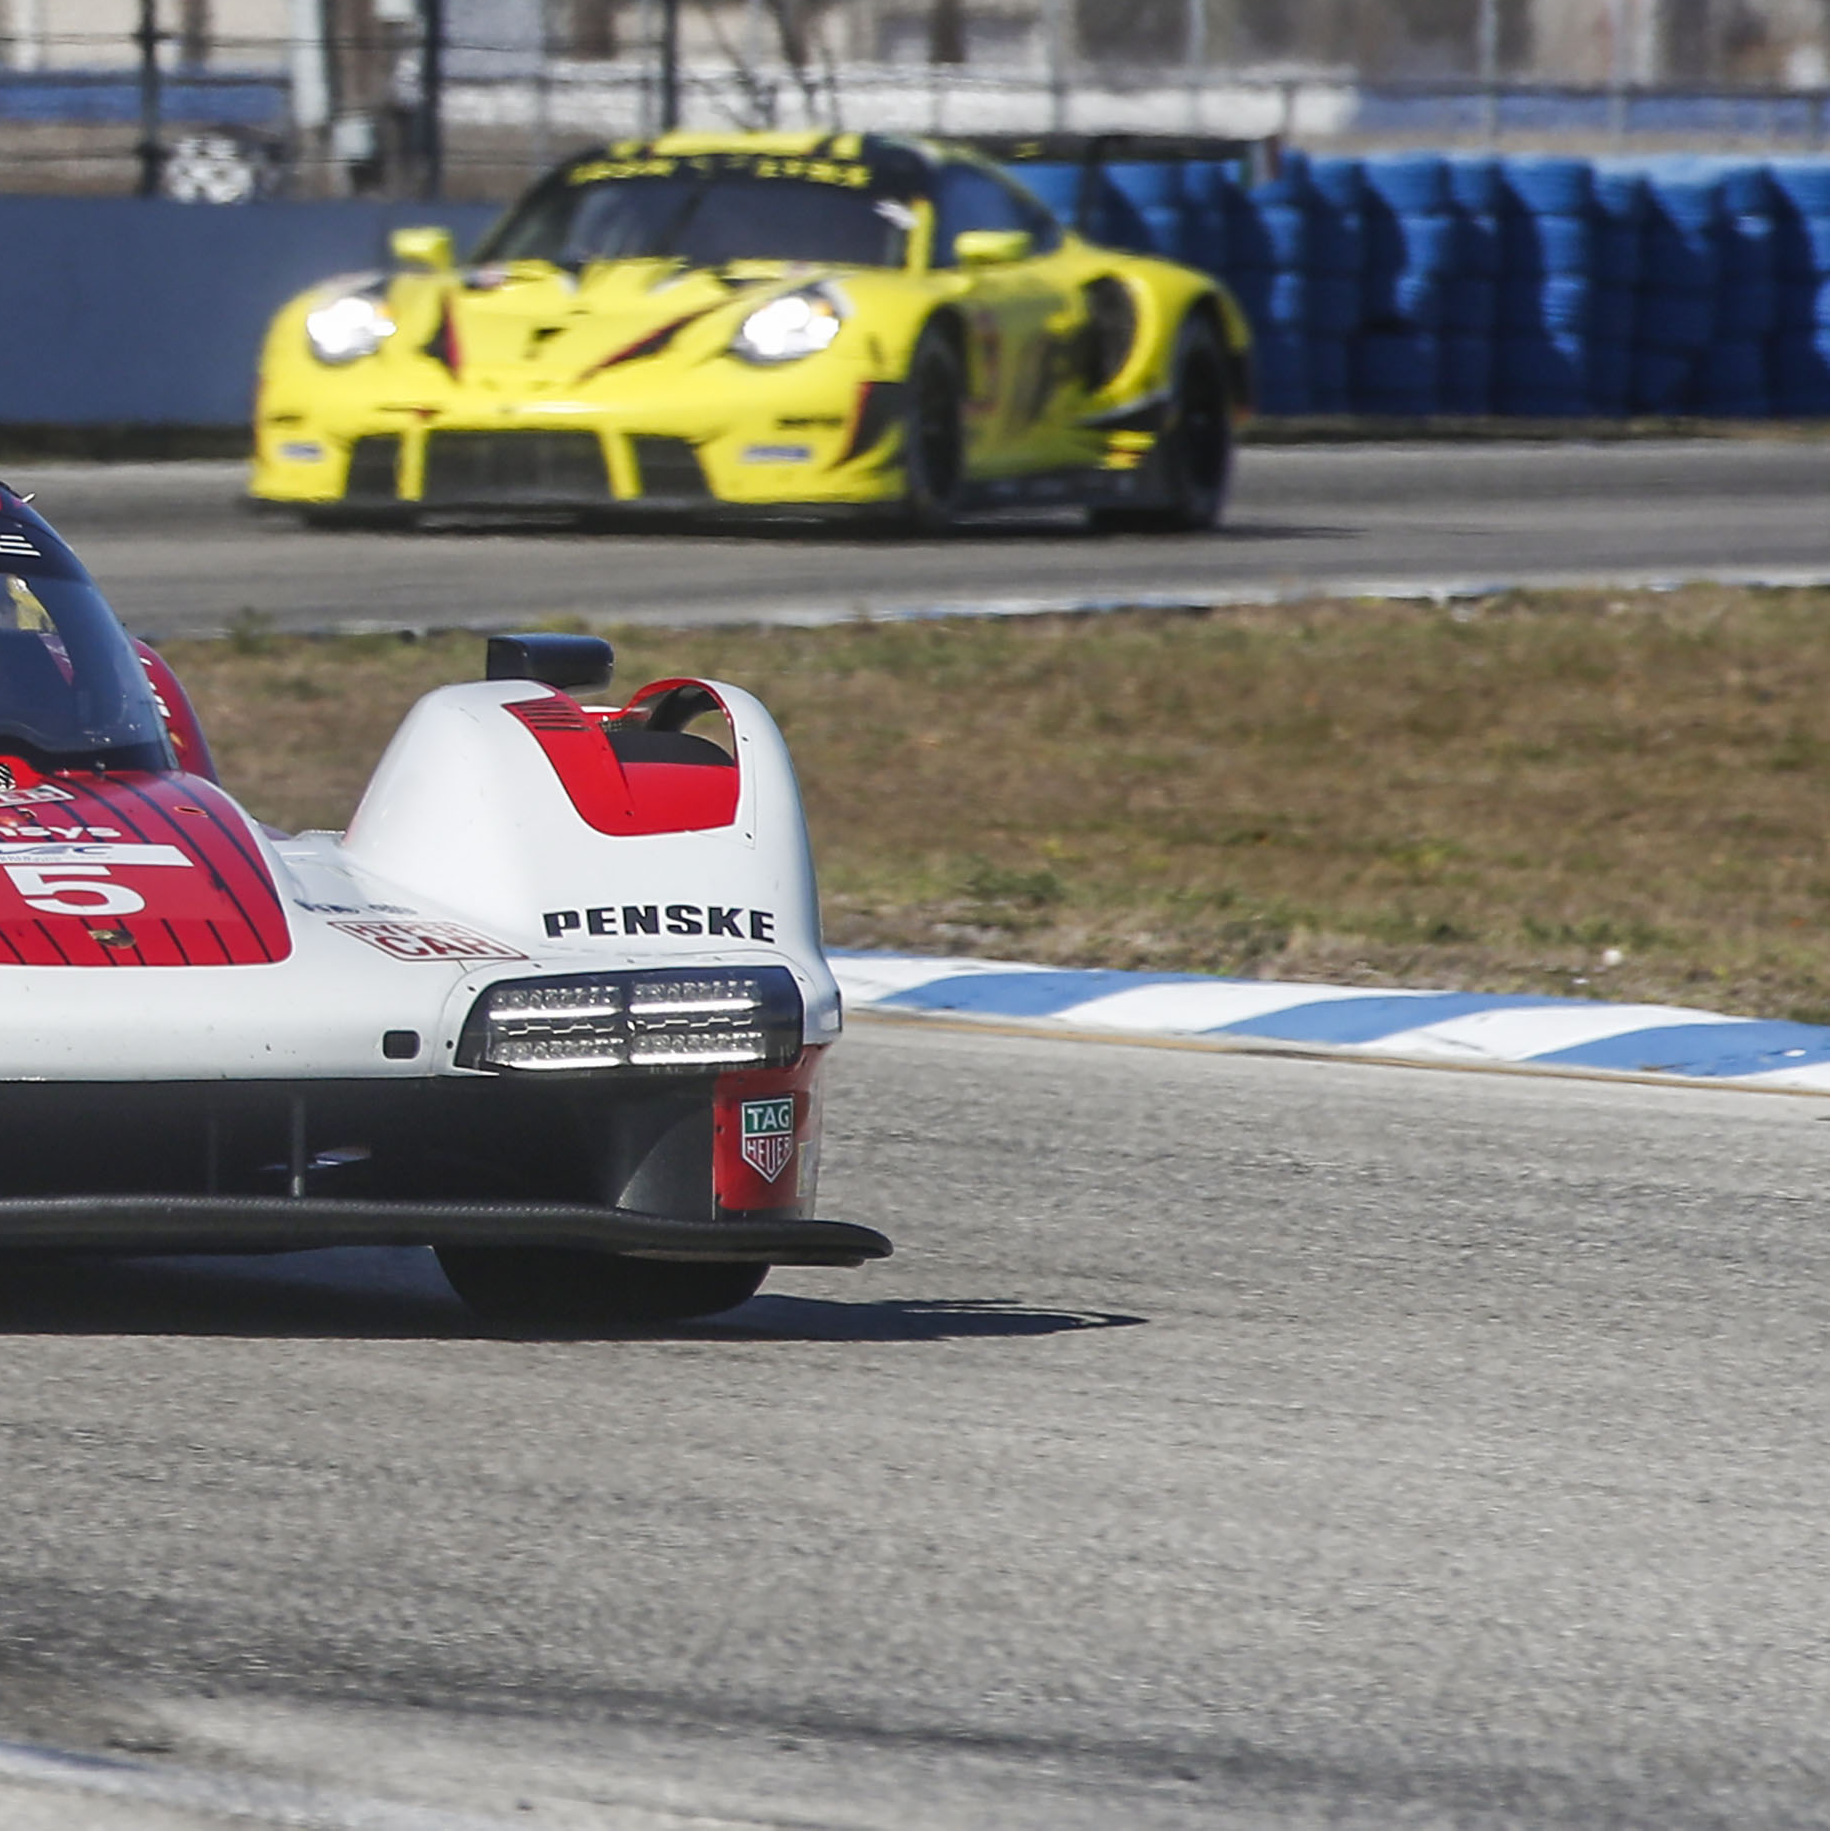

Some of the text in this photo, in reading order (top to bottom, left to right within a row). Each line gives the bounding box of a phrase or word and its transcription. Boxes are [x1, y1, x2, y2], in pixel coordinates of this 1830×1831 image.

[3, 866, 146, 916] 5
[541, 905, 776, 944] PENSKE
[374, 936, 511, 956] CAR
[747, 1105, 790, 1130] TAG
[746, 1136, 790, 1175] HEUER
